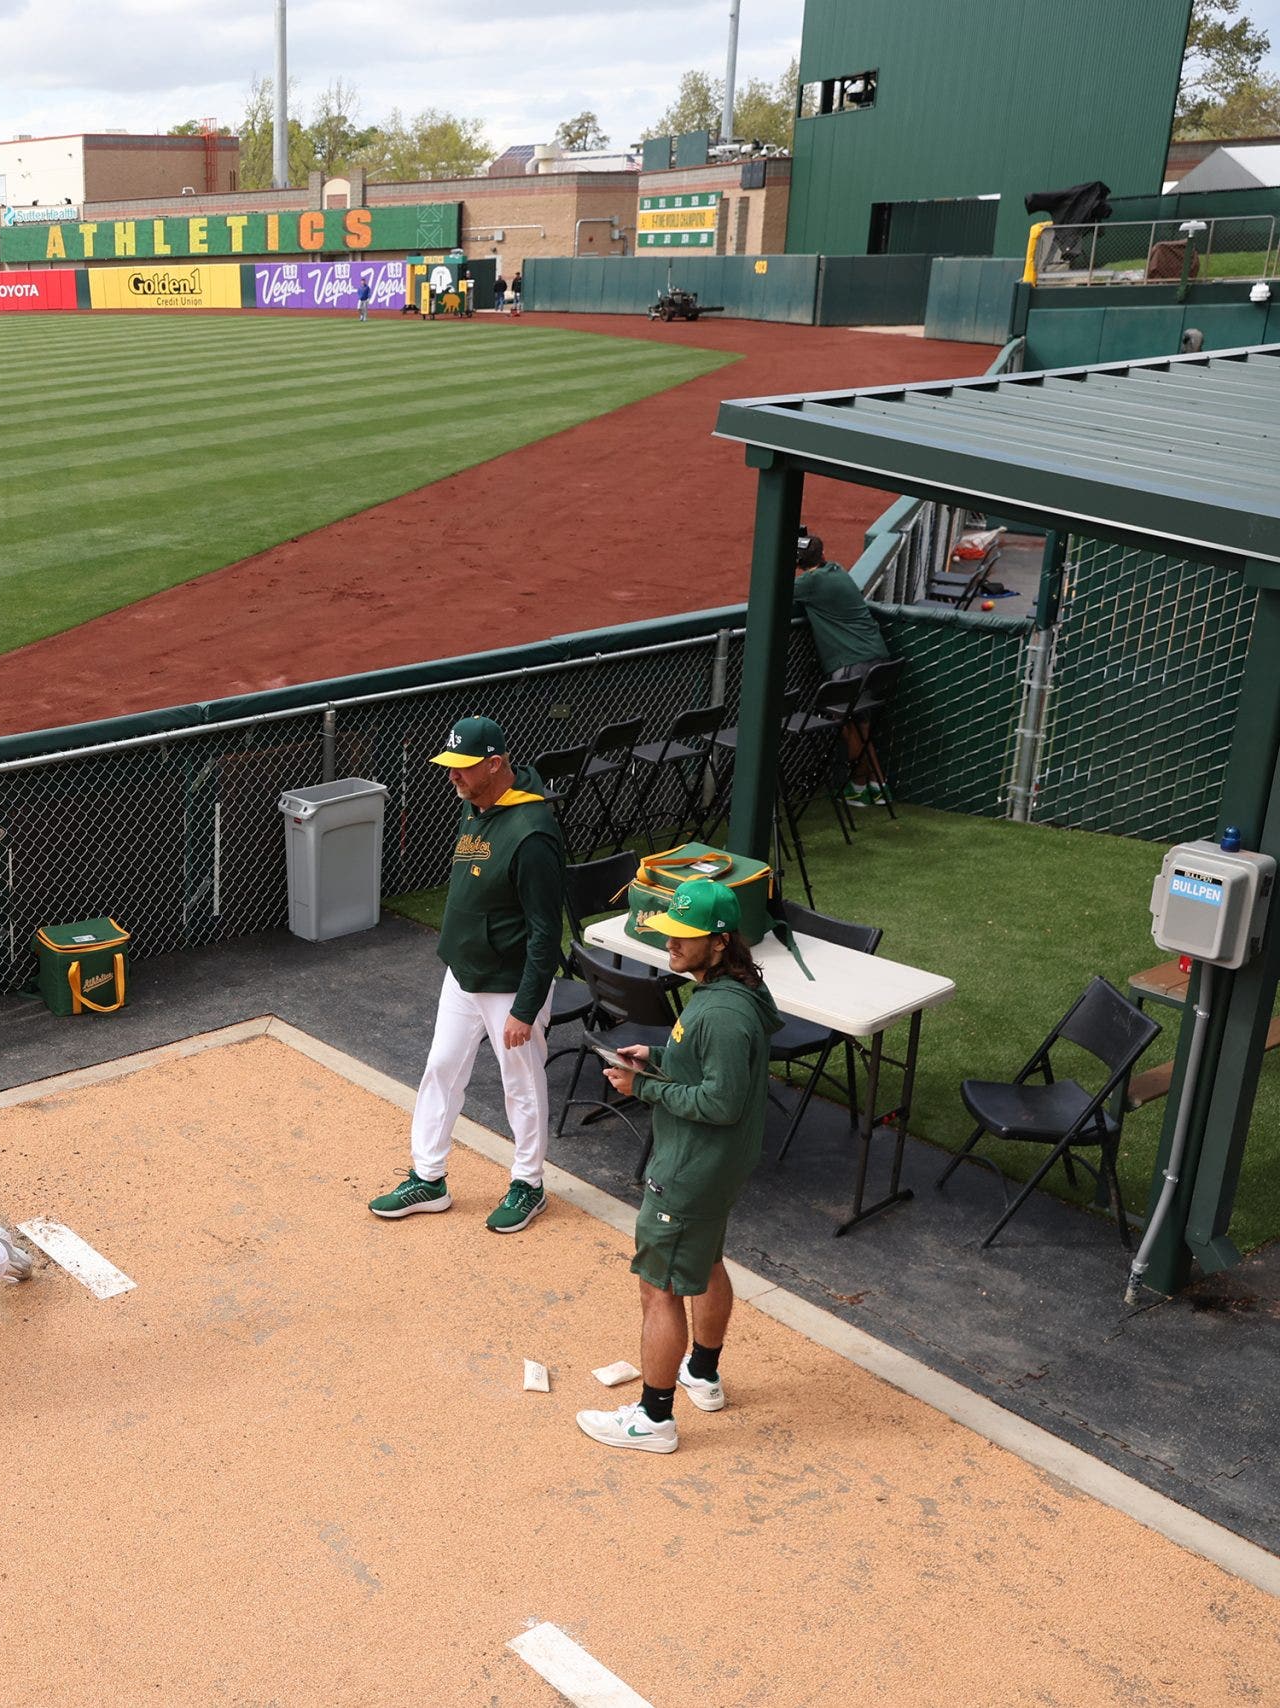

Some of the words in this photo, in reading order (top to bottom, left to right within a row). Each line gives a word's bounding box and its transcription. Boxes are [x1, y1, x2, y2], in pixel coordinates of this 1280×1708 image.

[256, 267, 306, 307] Vegas
[308, 266, 358, 307] Vegas
[360, 265, 406, 307] Vegas
[156, 297, 179, 307] Credit
[181, 296, 203, 306] Union
[447, 730, 463, 749] A's
[1184, 871, 1213, 884] BULLPEN
[1172, 879, 1222, 902] BULLPEN
